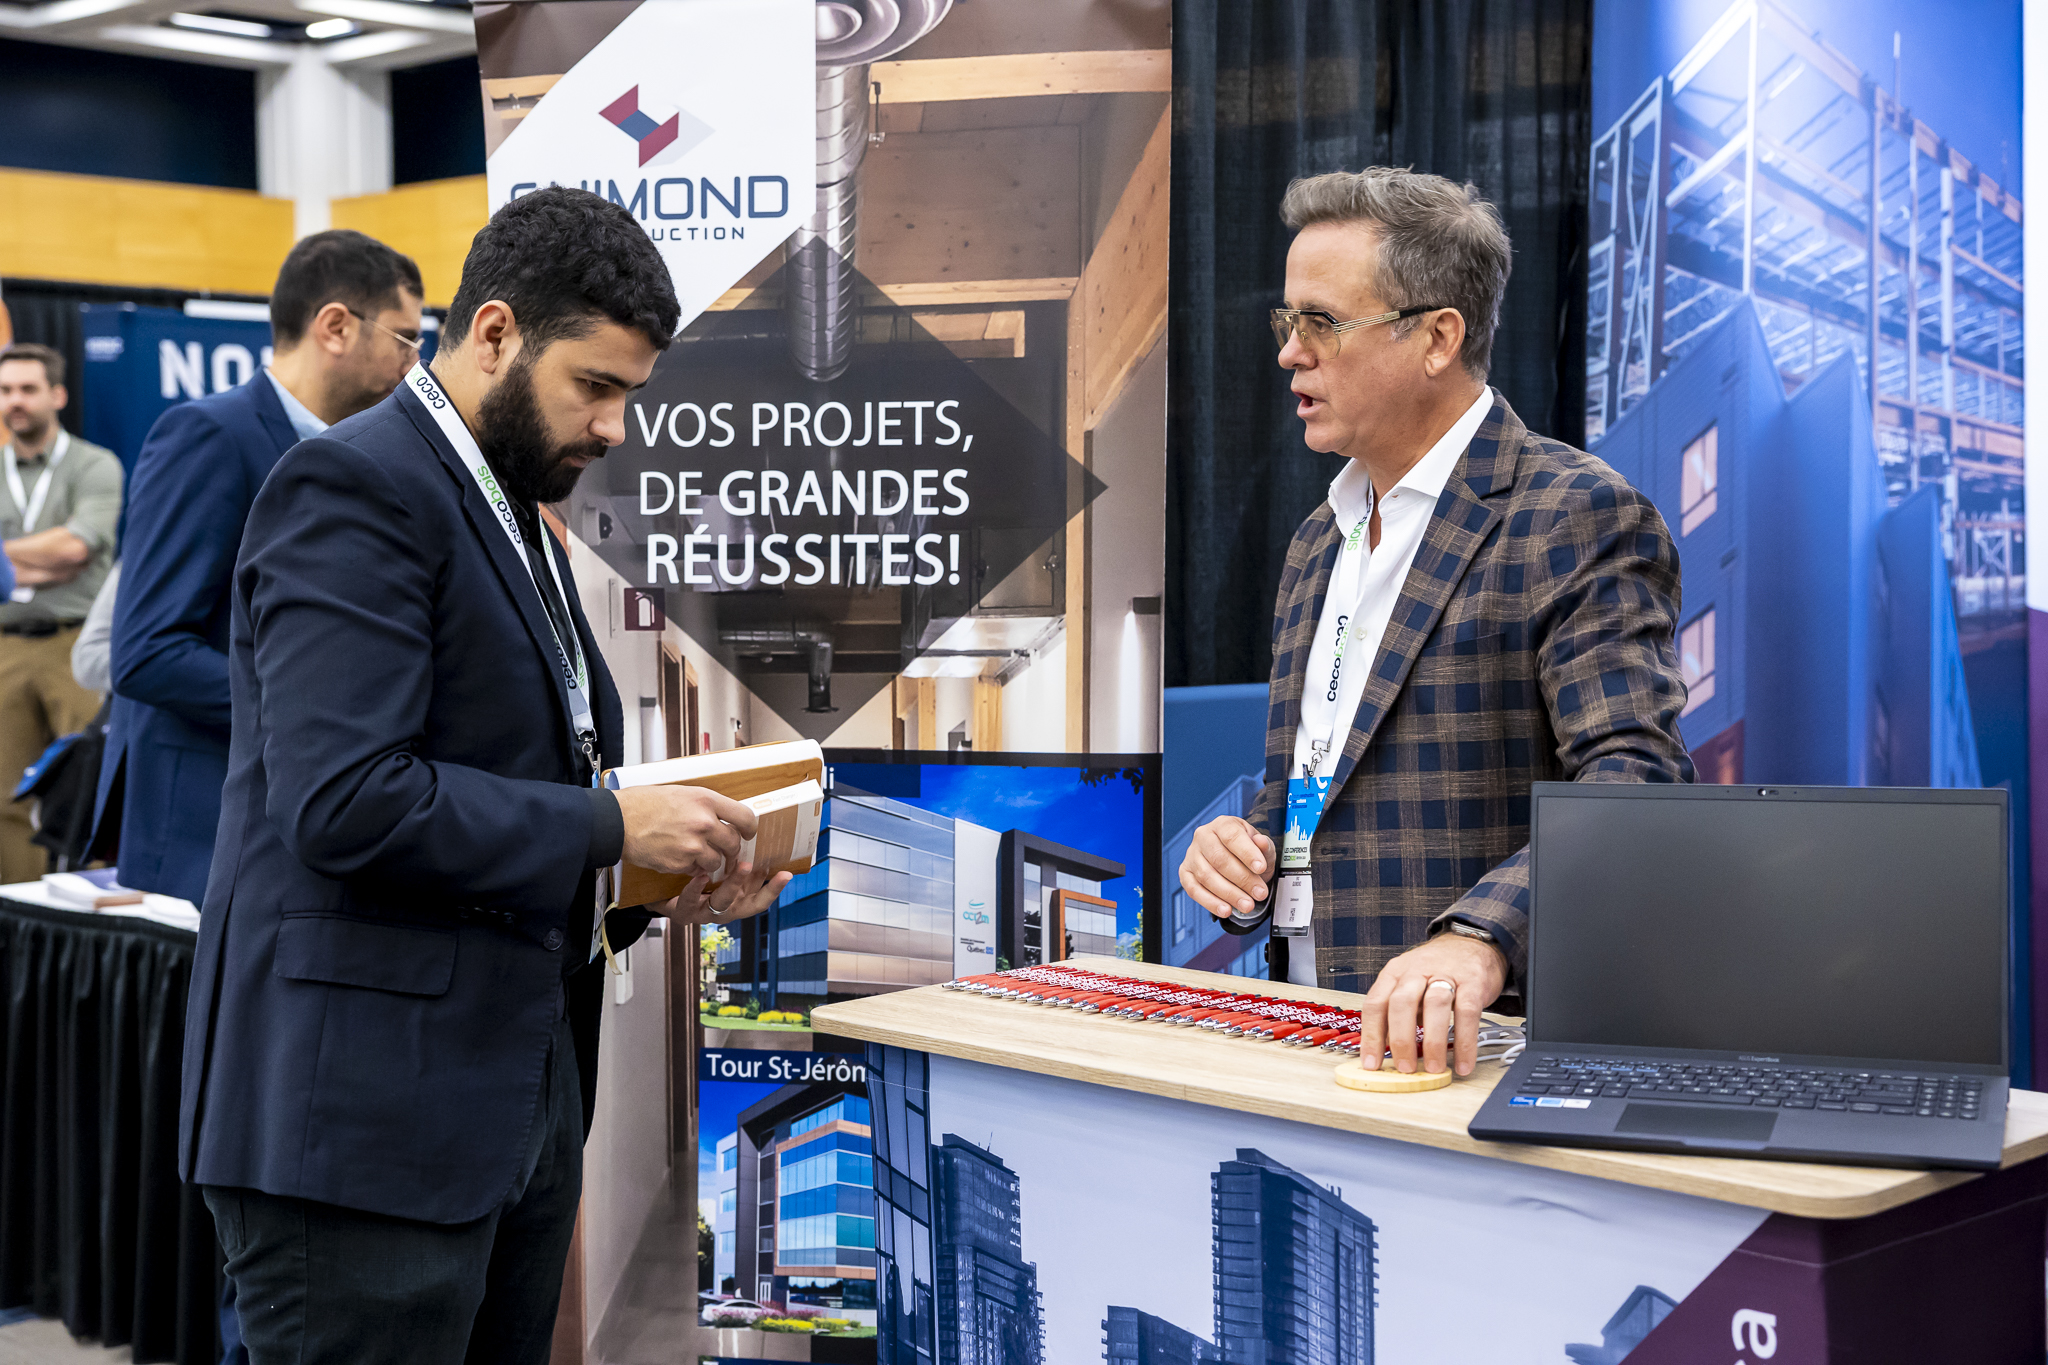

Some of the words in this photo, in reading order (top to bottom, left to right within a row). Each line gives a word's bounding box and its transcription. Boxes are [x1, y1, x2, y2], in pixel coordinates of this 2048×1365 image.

[511, 175, 789, 221] MOND
[158, 338, 274, 400] NO
[634, 401, 736, 448] VOS
[752, 399, 974, 452] PROJETS,
[477, 465, 522, 545] cecobois
[639, 470, 704, 516] DE
[718, 468, 970, 517] GRANDES
[647, 523, 960, 586] RÉUSSITES!
[706, 1053, 763, 1078] Tour
